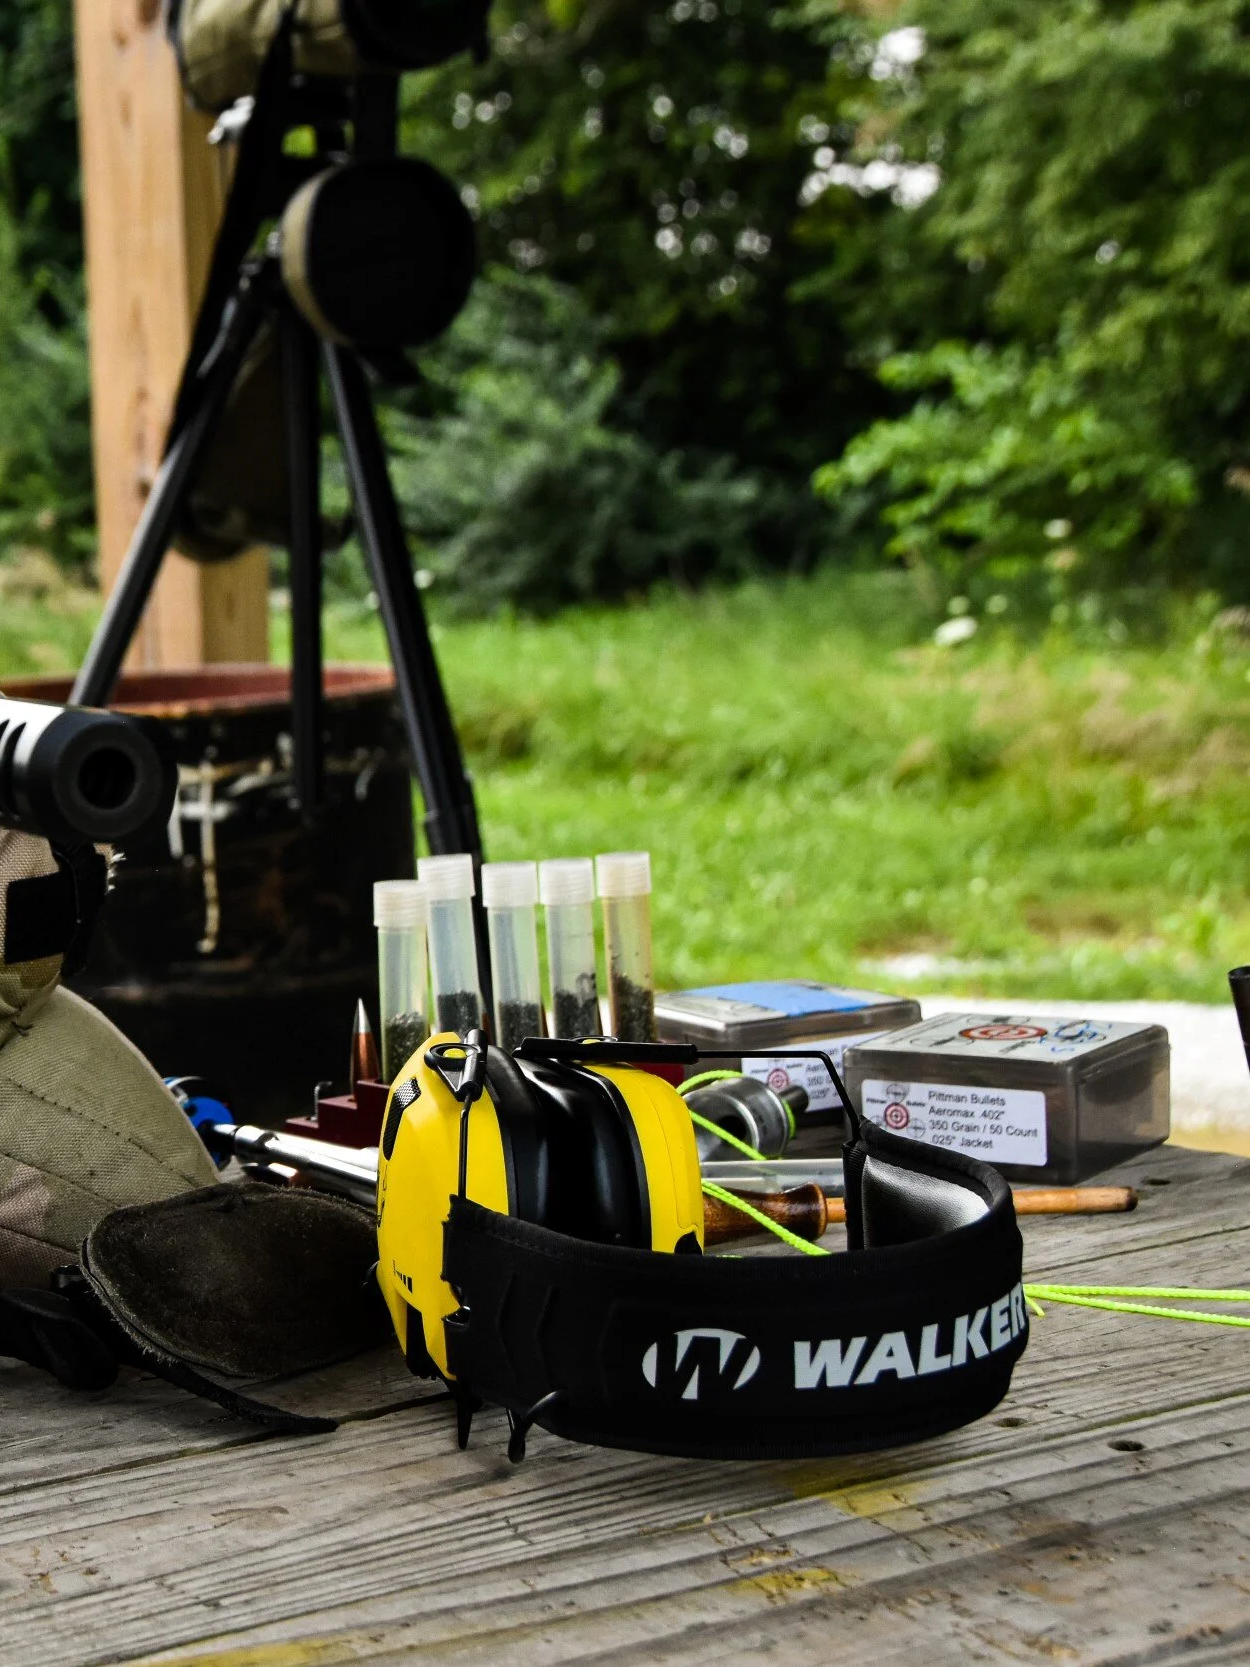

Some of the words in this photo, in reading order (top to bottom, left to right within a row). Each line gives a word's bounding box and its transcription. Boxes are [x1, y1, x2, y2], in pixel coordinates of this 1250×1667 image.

[928, 1090, 967, 1104] Pittman
[970, 1093, 1006, 1107] Bullets
[928, 1106, 975, 1118] Aeromax
[928, 1119, 949, 1131] 350
[951, 1120, 981, 1133] Grain
[989, 1124, 1004, 1136] 50
[1005, 1125, 1038, 1138] Count
[959, 1136, 994, 1149] Jacket
[793, 1281, 1026, 1390] WALKER
